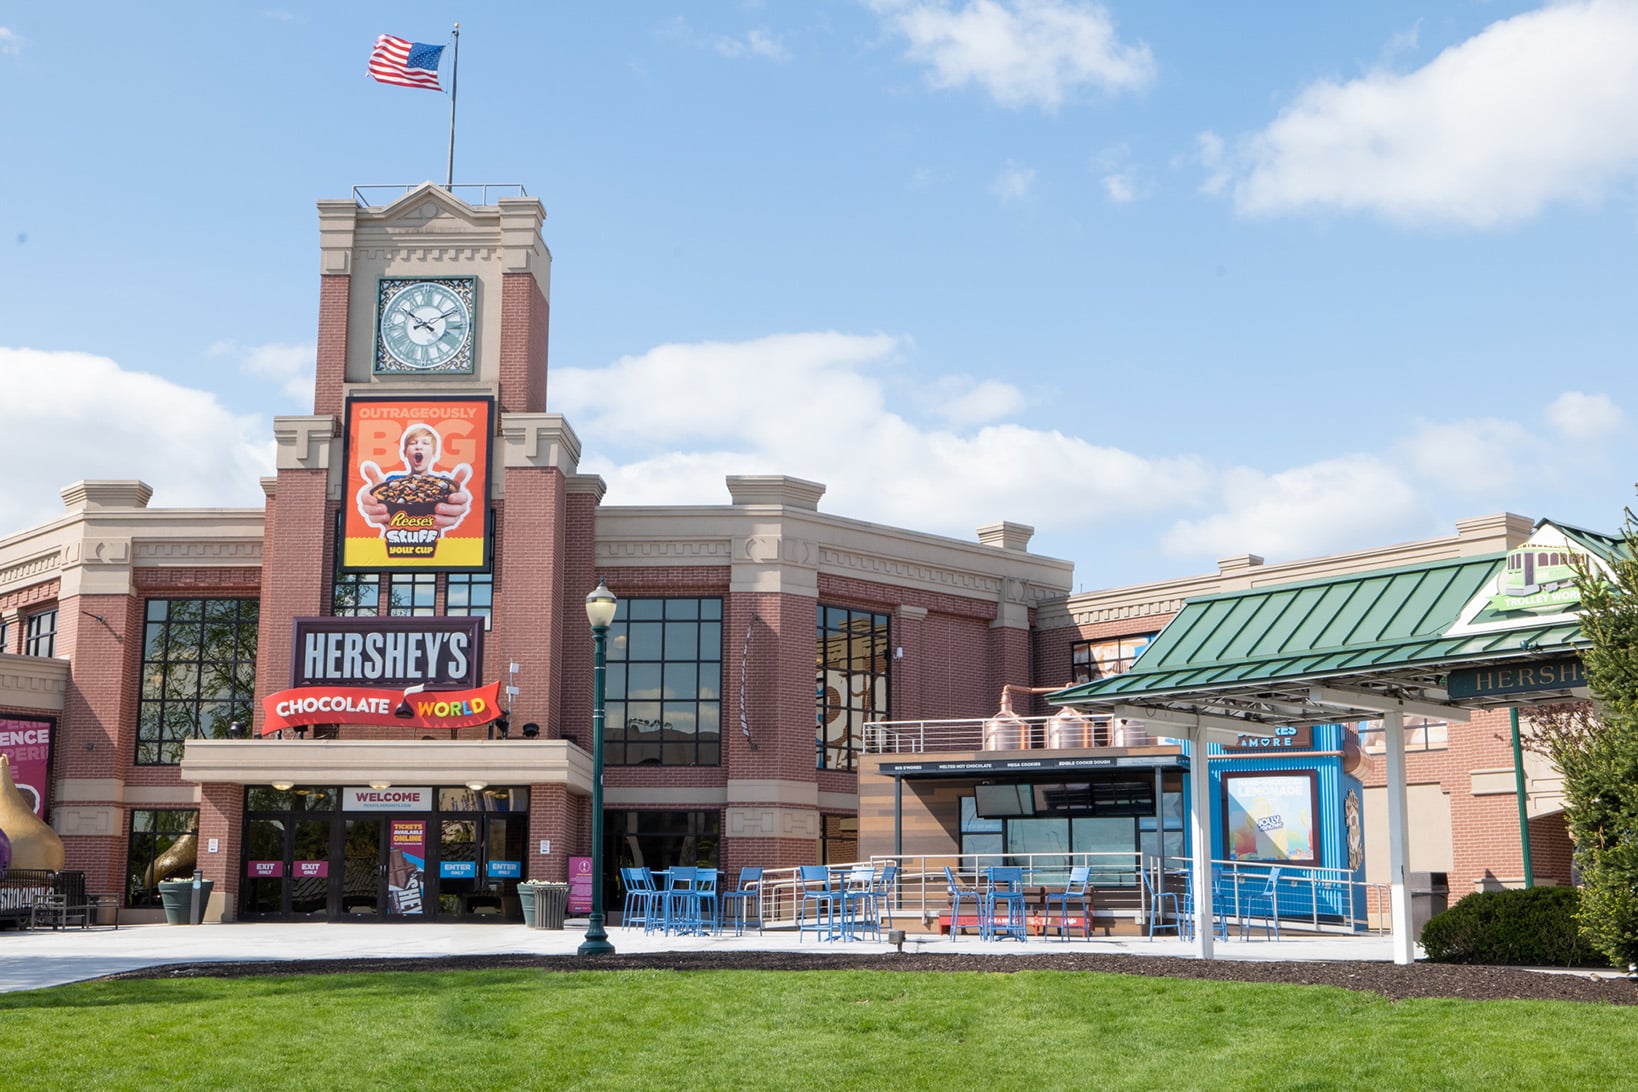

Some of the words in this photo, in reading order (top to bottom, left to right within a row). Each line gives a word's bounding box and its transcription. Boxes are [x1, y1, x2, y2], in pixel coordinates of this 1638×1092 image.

[359, 407, 477, 419] OUTRAGEOUSLY
[357, 419, 476, 468] BG
[1505, 593, 1549, 607] TROLLEY
[304, 632, 468, 680] HERSHEY'S
[276, 696, 390, 717] CHOCOLATE
[418, 697, 485, 717] WORLD
[356, 792, 420, 802] WELCOME
